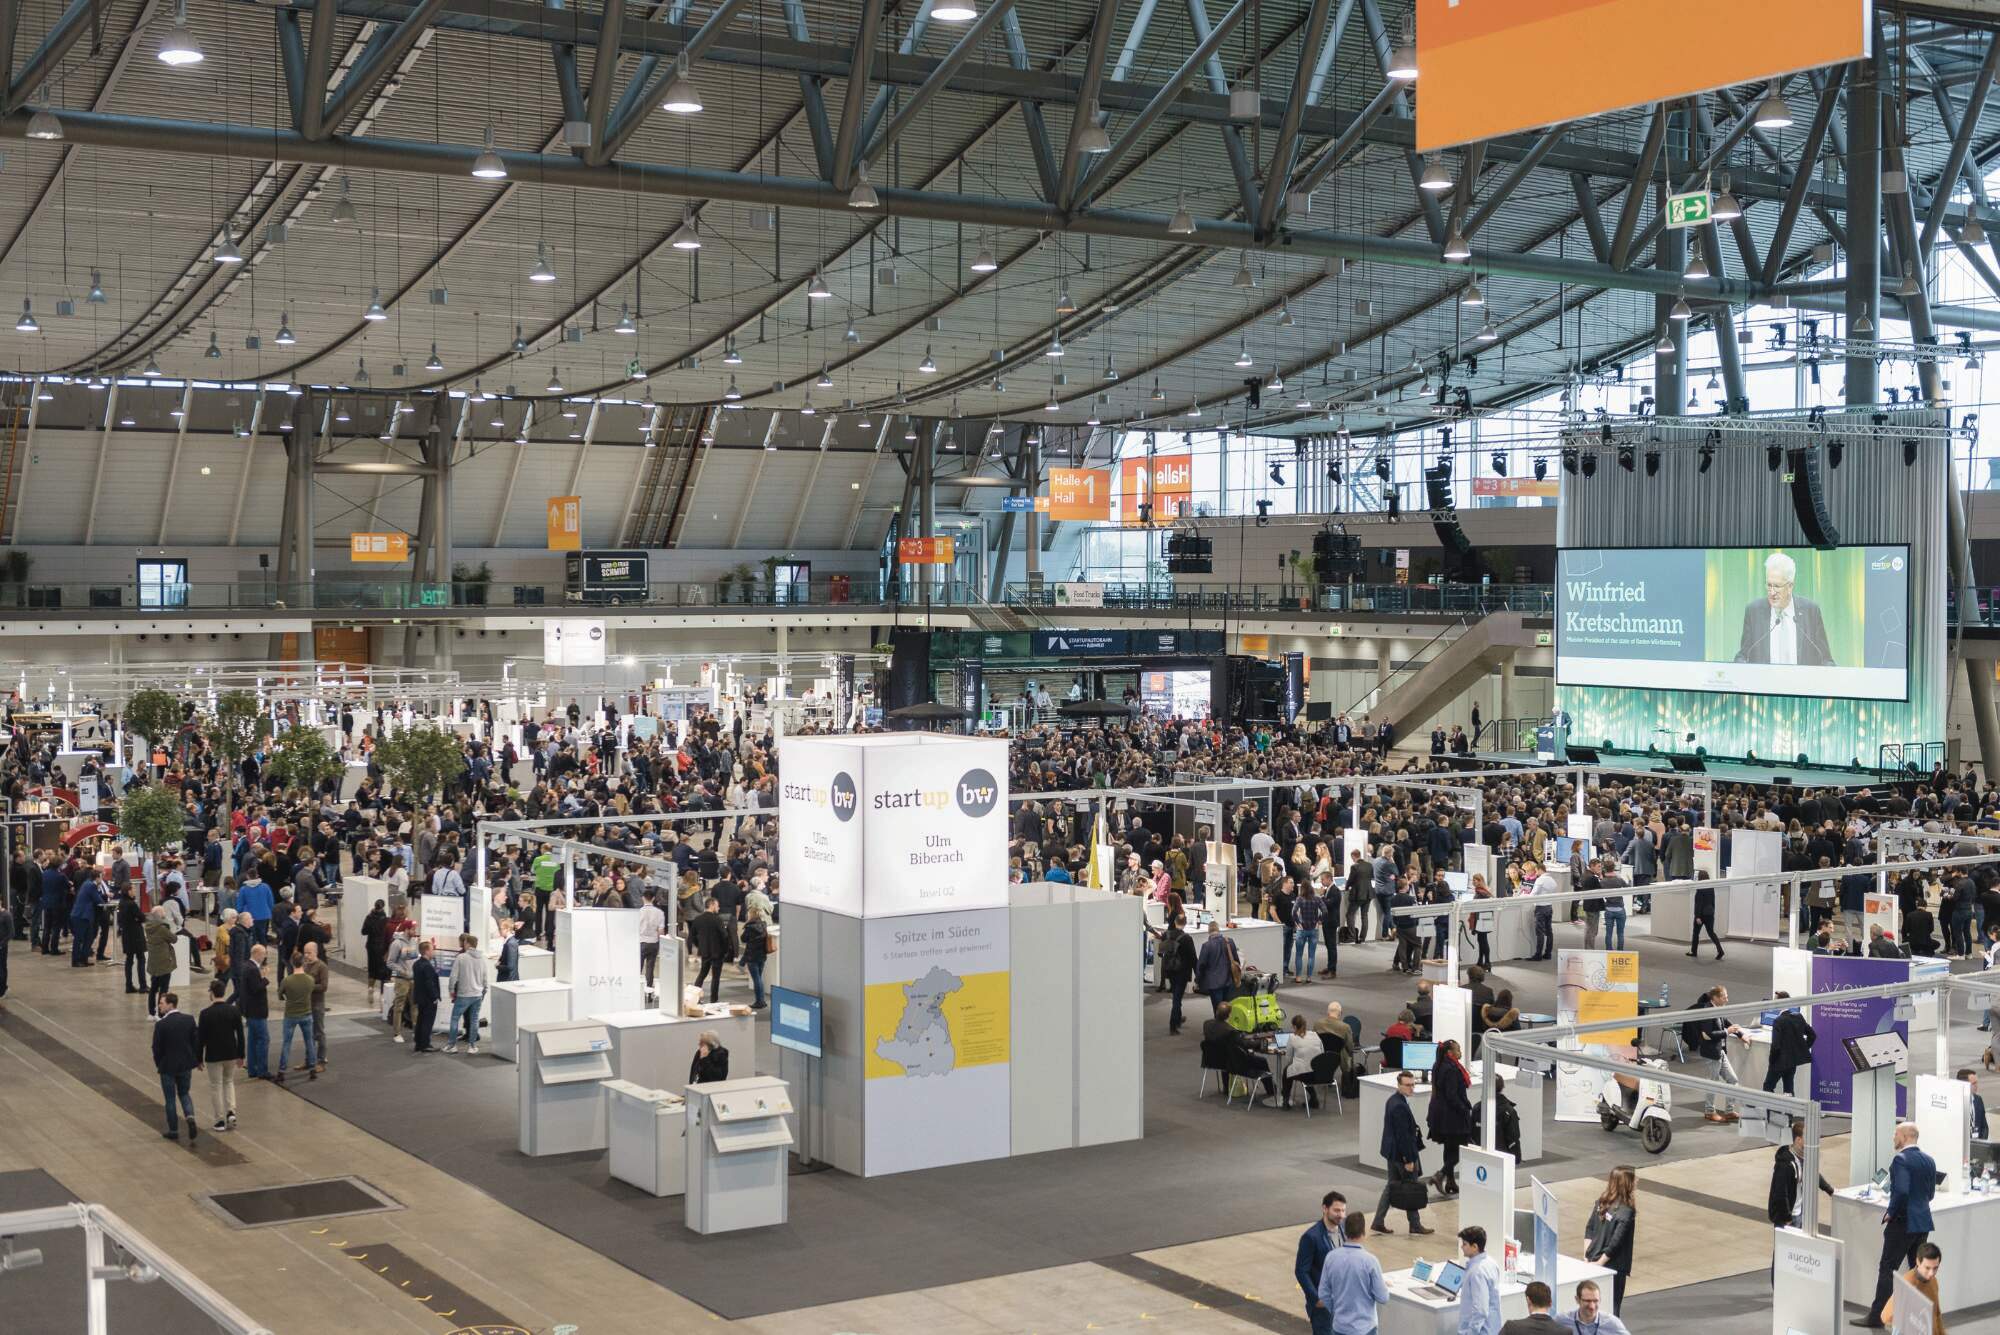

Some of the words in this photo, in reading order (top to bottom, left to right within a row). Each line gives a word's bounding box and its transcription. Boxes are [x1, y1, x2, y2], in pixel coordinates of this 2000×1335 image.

[1054, 474, 1081, 487] Halle
[1083, 474, 1095, 504] 1
[1054, 491, 1075, 504] Hall
[916, 540, 923, 556] 3
[601, 566, 630, 577] SCHMIDT
[1565, 581, 1646, 602] Winfried
[1566, 612, 1684, 634] Kretschmann
[784, 780, 827, 808] startup
[833, 784, 855, 809] bw
[873, 787, 950, 812] startup
[961, 783, 994, 805] bw
[812, 831, 829, 847] Ulm
[925, 835, 952, 848] Ulm
[803, 846, 836, 864] Biberach
[909, 850, 964, 866] Biberach
[894, 931, 928, 945] Spitze
[931, 927, 944, 940] im
[948, 925, 981, 939] Süden
[890, 951, 919, 960] Startups
[920, 947, 943, 957] treffen
[588, 975, 623, 987] DAY4
[1788, 1252, 1820, 1267] aucobo
